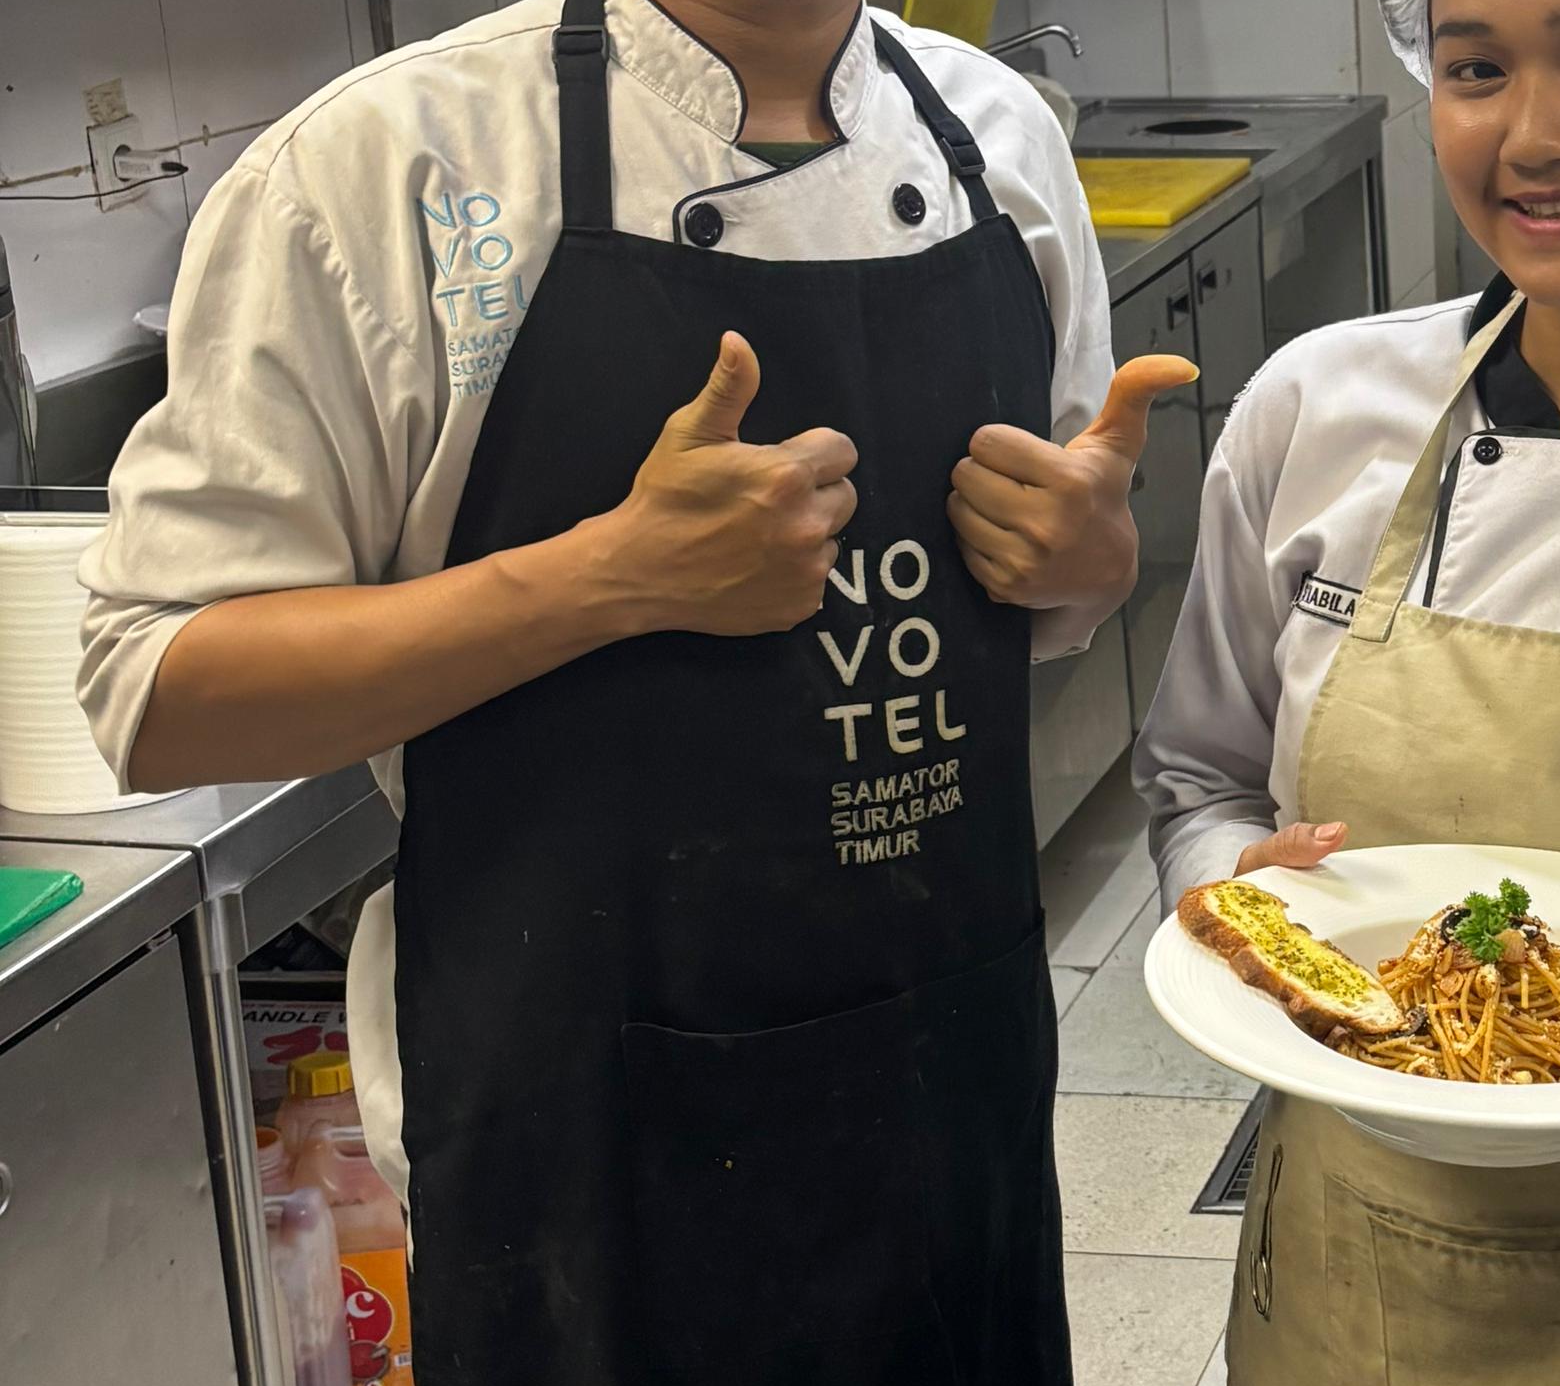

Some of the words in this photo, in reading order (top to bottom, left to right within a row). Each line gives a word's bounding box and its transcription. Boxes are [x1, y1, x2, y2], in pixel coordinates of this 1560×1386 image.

[431, 233, 513, 278] VO
[436, 275, 528, 327] TEL
[451, 352, 509, 377] SURA
[818, 539, 930, 610] NO
[816, 617, 941, 686] VO
[824, 690, 967, 762] TEL
[832, 758, 961, 808] SAMATOR
[831, 786, 964, 837] SURABAYA
[835, 829, 921, 865] TIMUR
[243, 1010, 330, 1024] ANDLE
